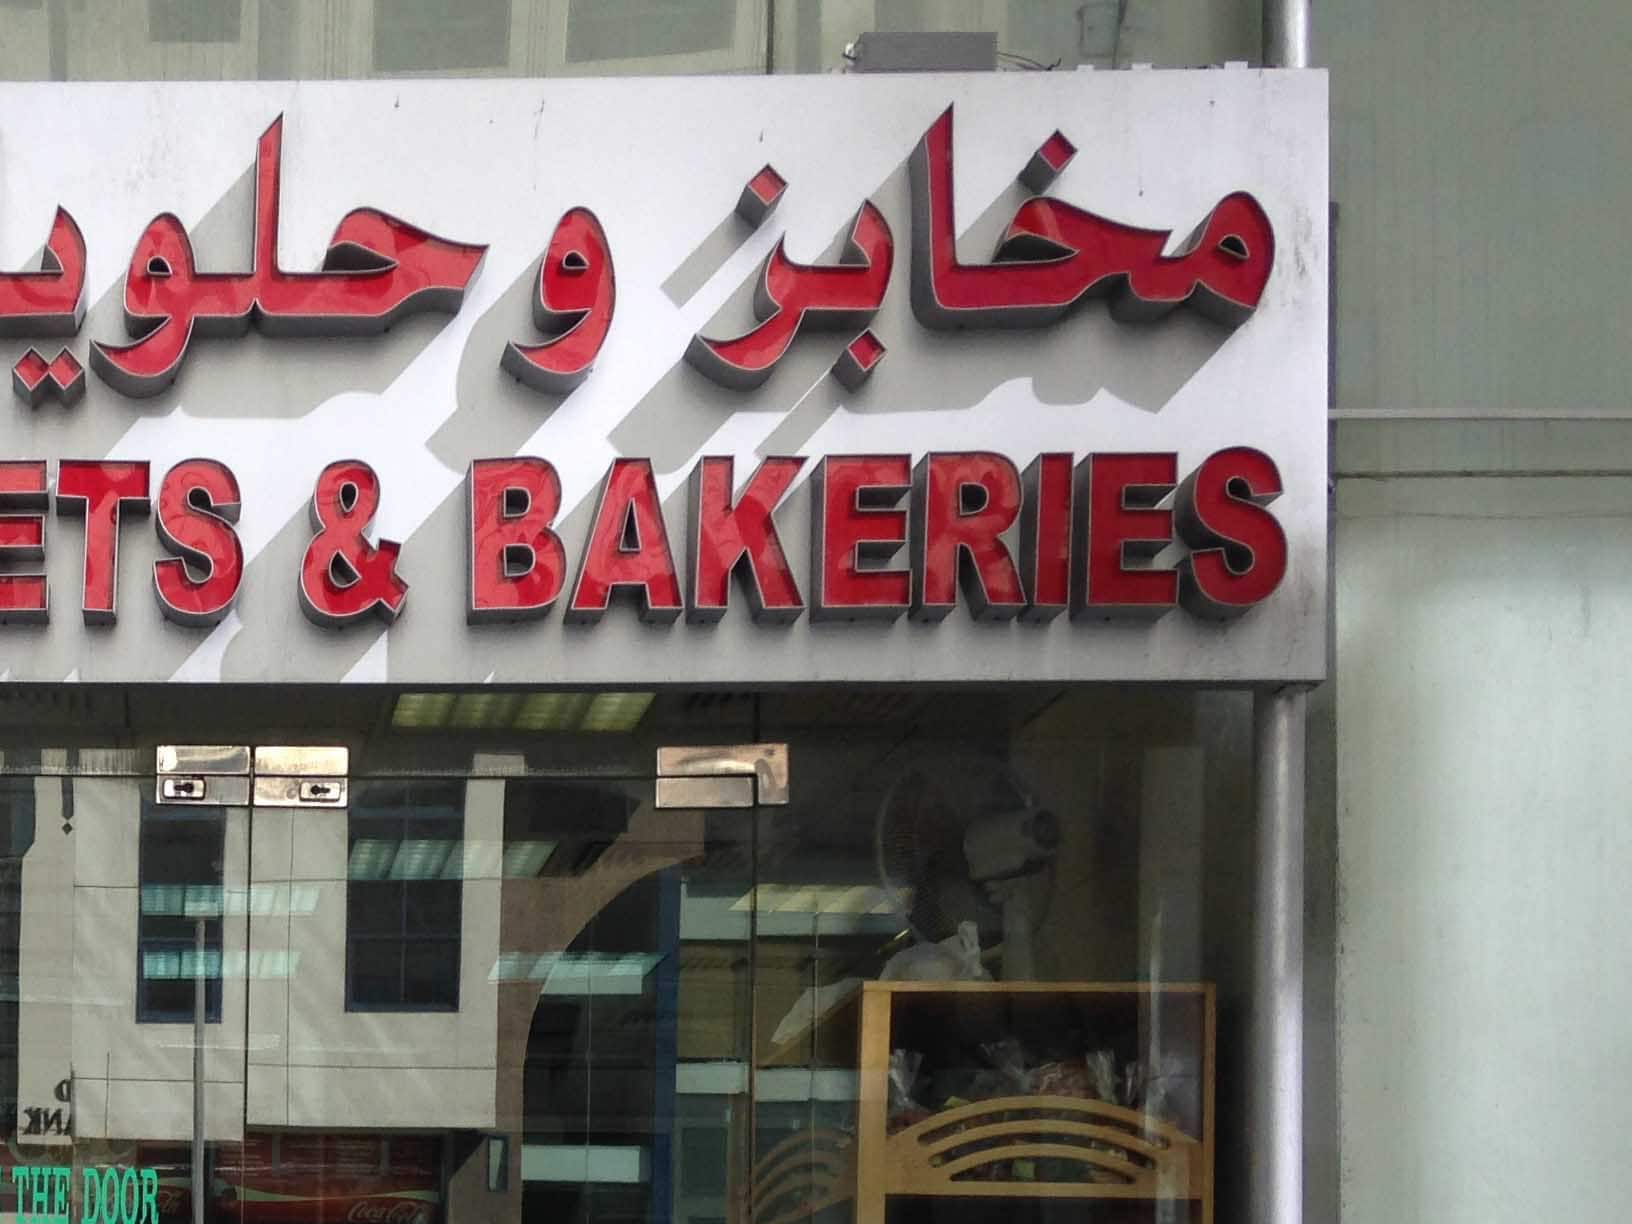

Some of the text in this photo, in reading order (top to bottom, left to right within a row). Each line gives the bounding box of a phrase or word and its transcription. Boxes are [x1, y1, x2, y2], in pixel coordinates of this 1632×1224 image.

[692, 103, 1275, 372] مخابز
[300, 459, 409, 618] &
[469, 447, 1288, 608] BAKERIES
